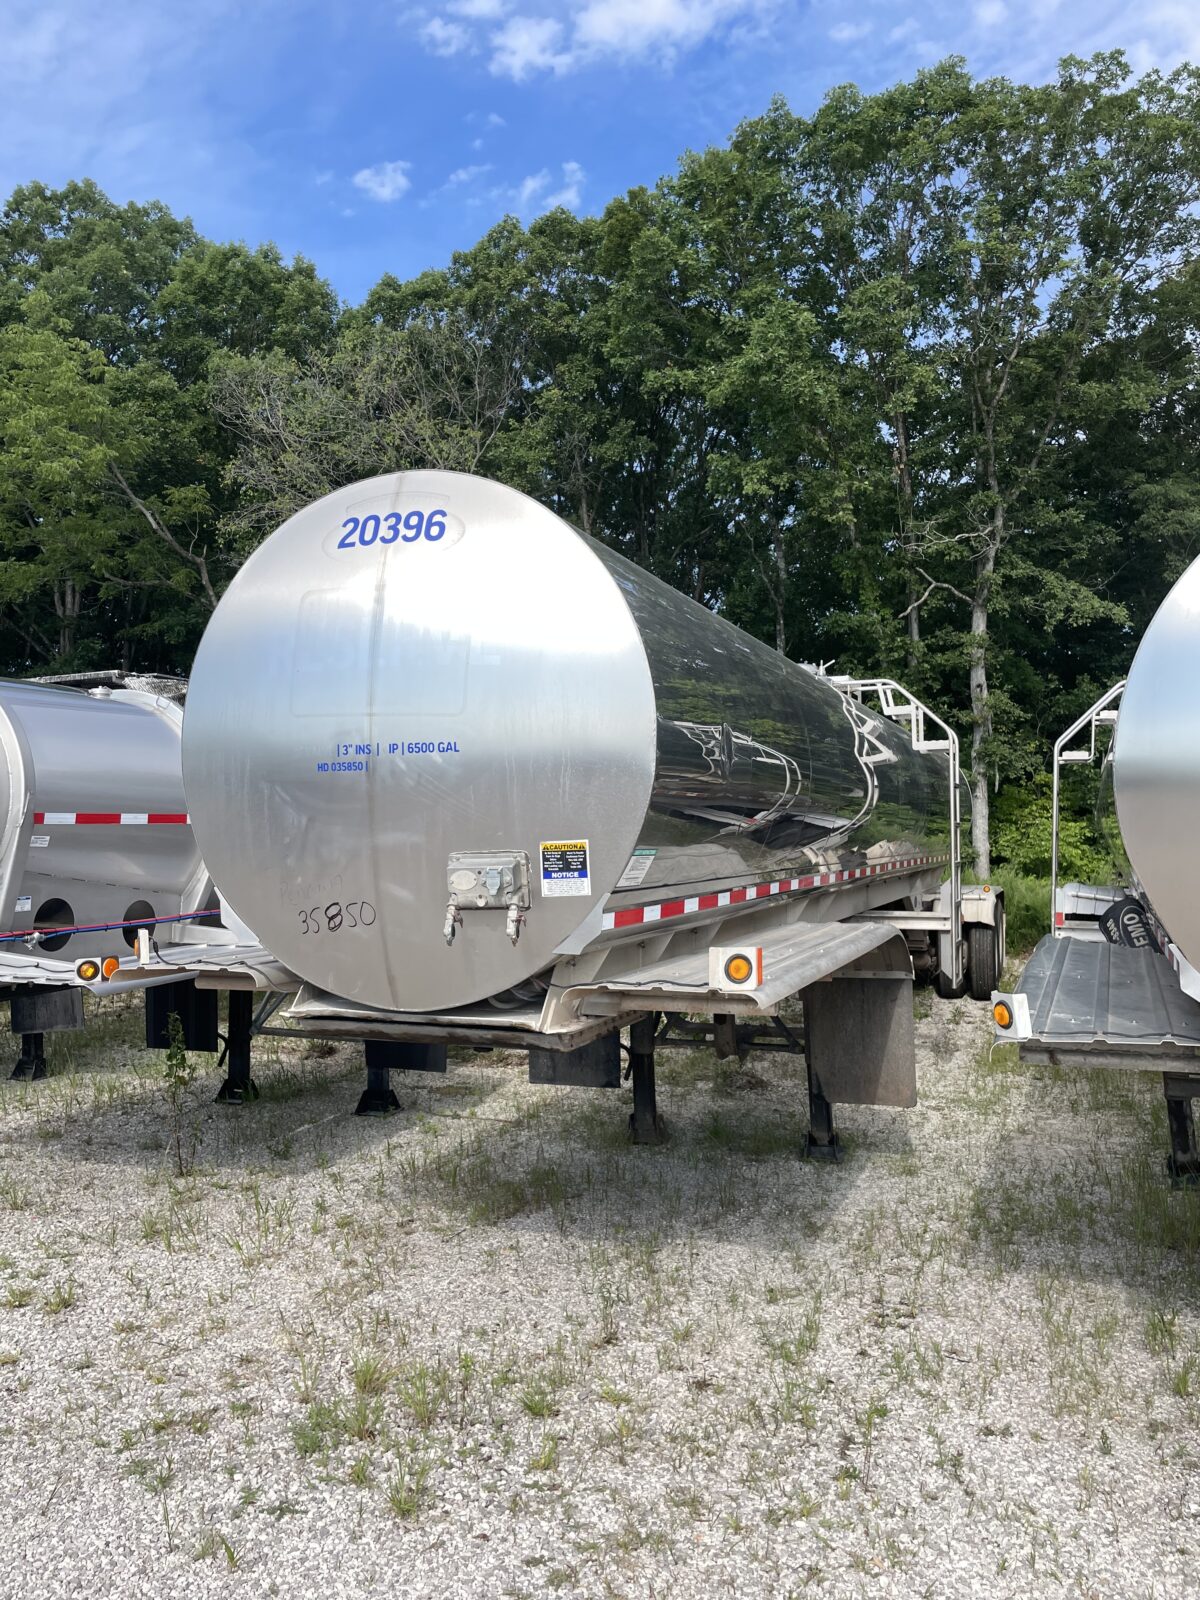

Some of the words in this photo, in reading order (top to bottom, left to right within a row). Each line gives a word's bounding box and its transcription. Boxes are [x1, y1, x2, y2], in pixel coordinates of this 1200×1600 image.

[337, 509, 448, 550] 20396
[355, 744, 371, 755] INS
[388, 743, 398, 754] IP
[407, 742, 435, 754] 6500
[437, 742, 460, 753] GAL
[317, 763, 329, 772] HD
[331, 761, 363, 772] 035850
[298, 901, 376, 935] 35850
